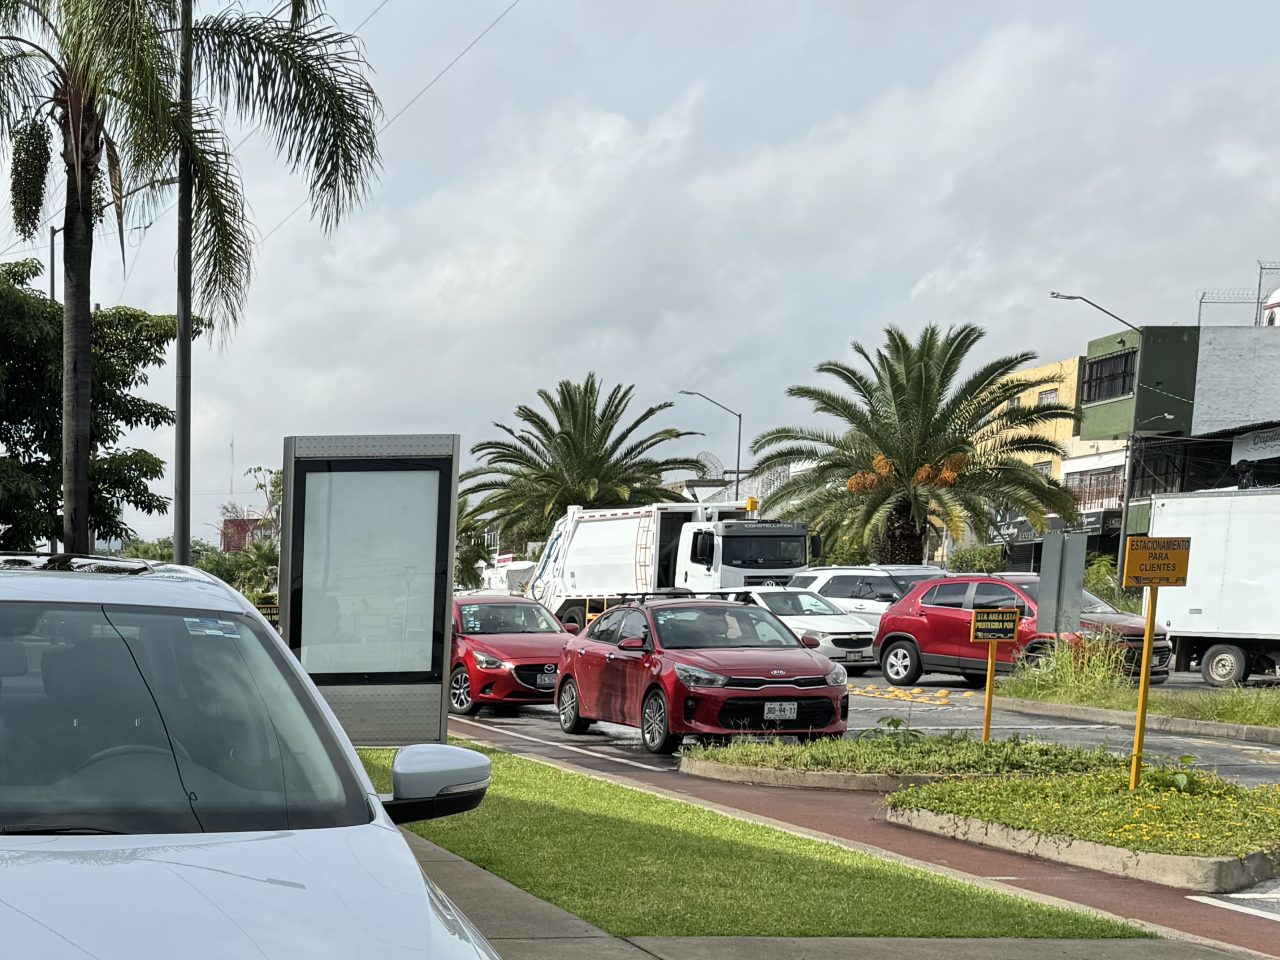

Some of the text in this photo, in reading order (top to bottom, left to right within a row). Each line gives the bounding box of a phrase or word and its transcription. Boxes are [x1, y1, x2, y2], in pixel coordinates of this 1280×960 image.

[1130, 540, 1190, 551] ESTACIONAMIENTO
[1148, 552, 1169, 561] PARA
[1139, 563, 1177, 572] CLIENTES
[1141, 576, 1185, 584] SCALA
